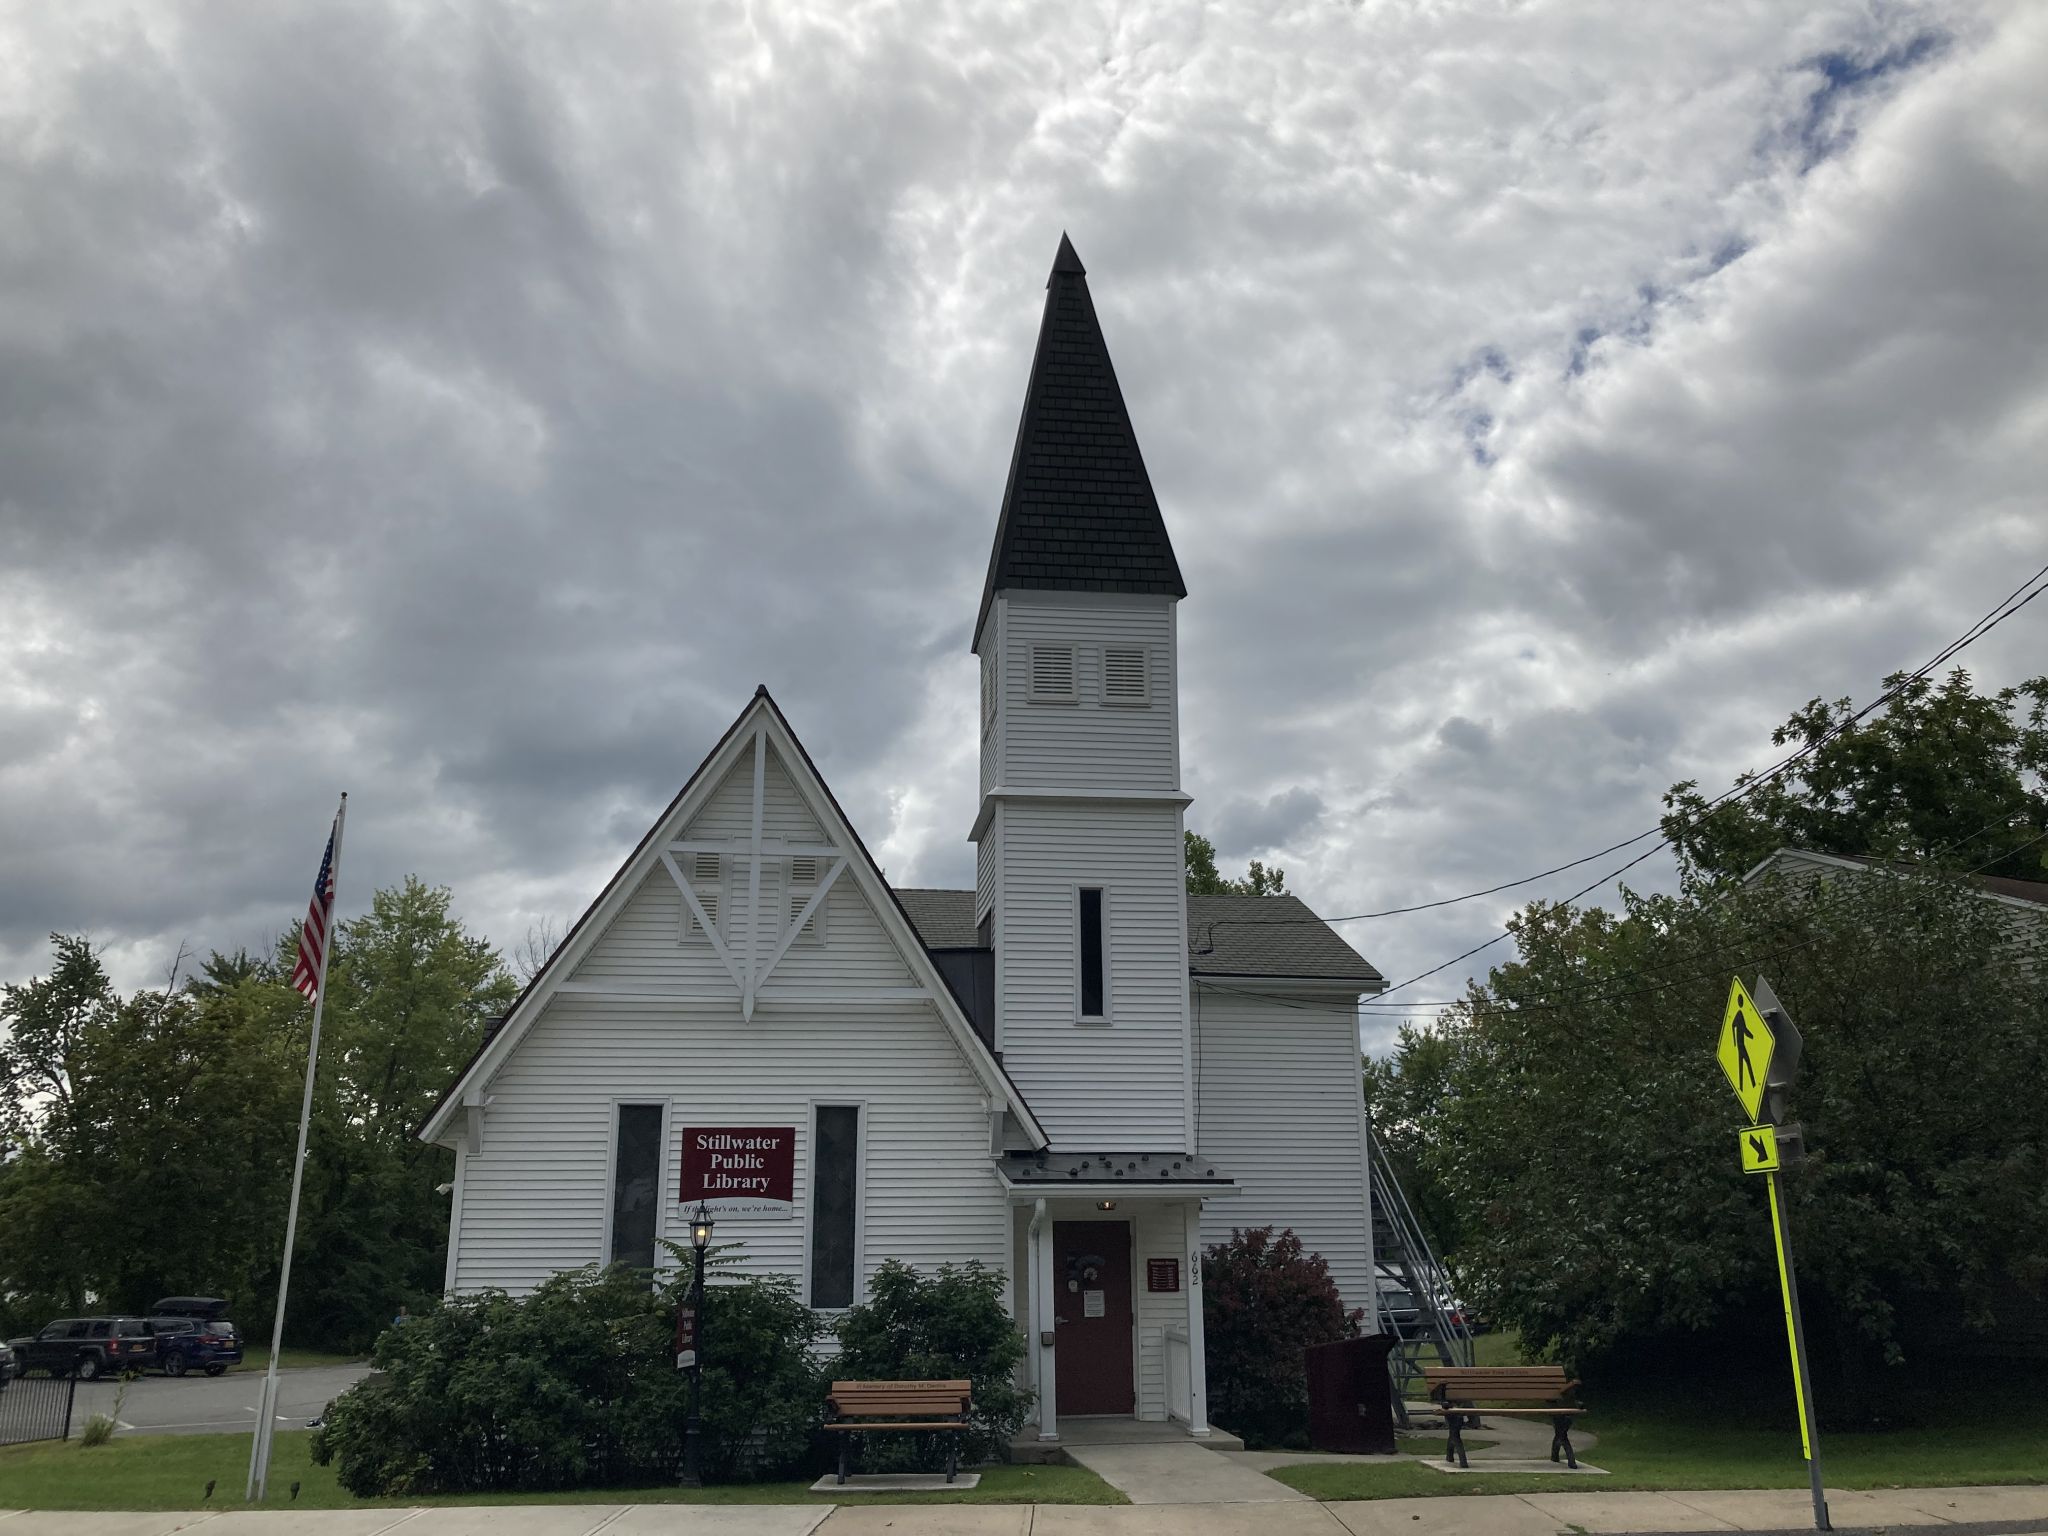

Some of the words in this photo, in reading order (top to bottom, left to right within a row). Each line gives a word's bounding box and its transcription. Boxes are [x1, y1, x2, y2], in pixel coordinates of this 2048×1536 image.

[697, 1135, 780, 1150] Stillwater
[711, 1154, 765, 1168] Public
[703, 1174, 770, 1192] Library
[1191, 1251, 1199, 1286] 662
